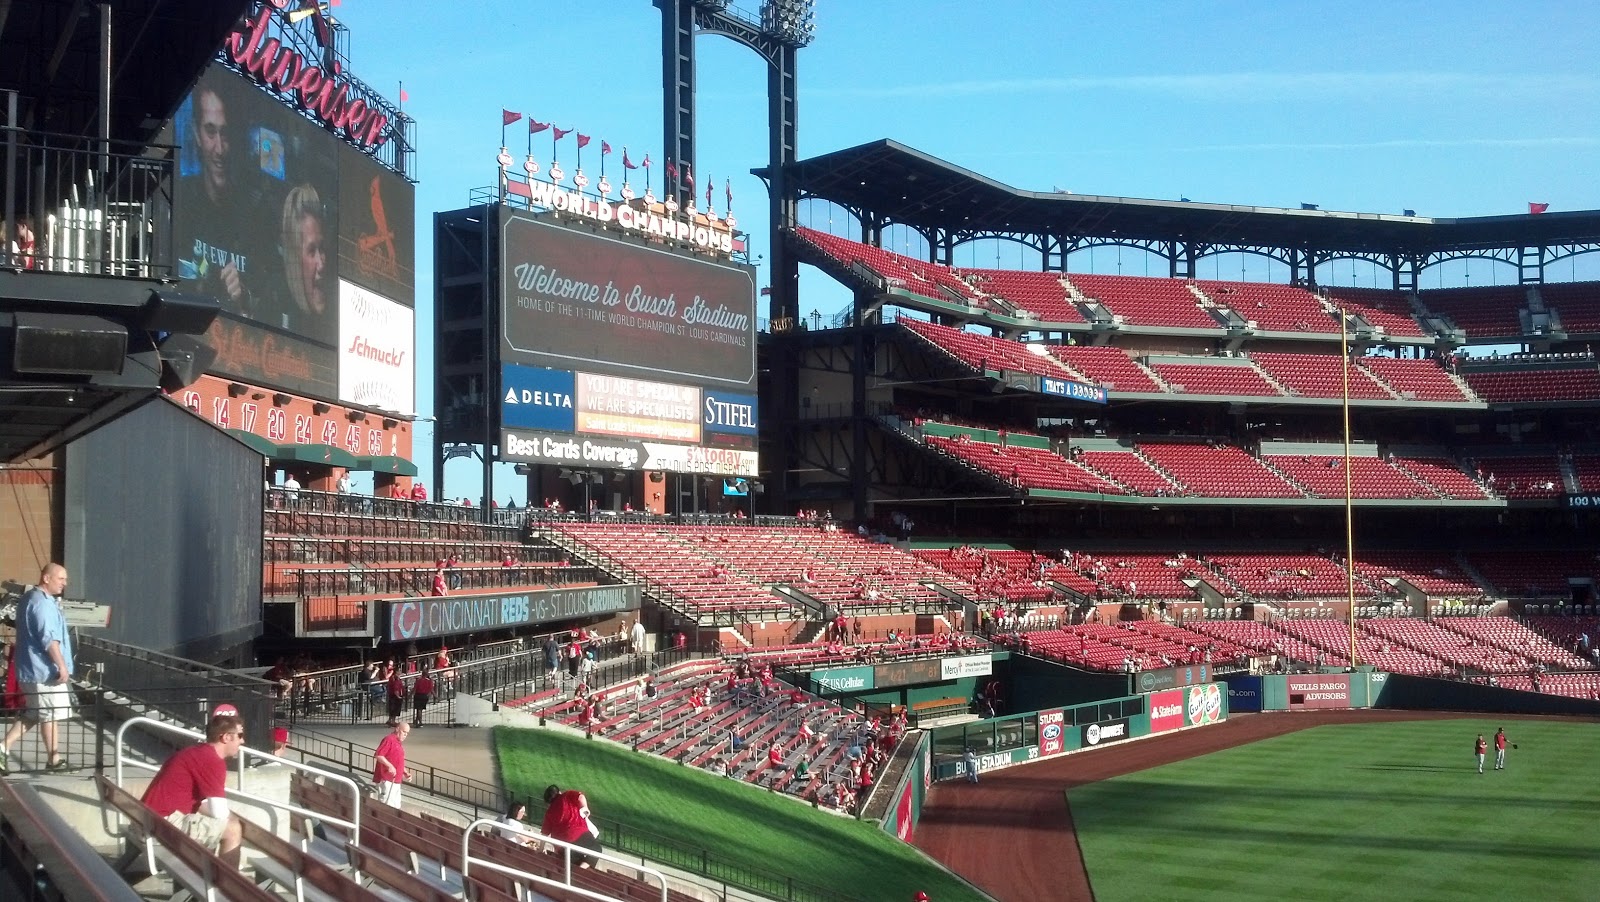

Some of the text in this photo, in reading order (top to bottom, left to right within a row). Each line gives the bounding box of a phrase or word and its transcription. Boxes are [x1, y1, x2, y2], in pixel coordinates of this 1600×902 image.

[529, 178, 733, 253] WORLD CHAMPIONS
[514, 262, 749, 332] Welcome to Busch Stadium
[517, 296, 542, 312] HOME
[545, 300, 556, 313] OF
[558, 303, 573, 317] THE
[576, 306, 606, 323] 11-TIME
[608, 313, 635, 328] WORLD
[637, 317, 676, 335] CHAMPION
[689, 327, 709, 341] LOUIS
[710, 331, 746, 347] CARDINALS
[348, 335, 405, 368] Schnucks
[522, 389, 572, 409] DELTA
[586, 376, 610, 394] YOU
[612, 379, 634, 397] ARE
[214, 397, 230, 429] 14
[242, 403, 258, 433] 17
[587, 395, 694, 421] WE ARE SPECIALISTS
[705, 396, 756, 429] STIFEL
[268, 408, 285, 440] 20
[295, 414, 312, 444] 24
[322, 420, 338, 448] 42
[345, 424, 361, 453] 45
[368, 429, 382, 456] 85
[507, 433, 638, 468] Best Cards Coverage
[429, 599, 499, 633] CINCINNATI
[501, 595, 529, 624] REDS
[564, 591, 586, 616] LOUIS
[587, 588, 627, 613] CARDINALS
[944, 665, 959, 676] Mercy
[1290, 682, 1346, 692] WELLS FARGO
[1306, 692, 1347, 701] ADVISORS
[1190, 696, 1204, 715] Gulf
[1205, 694, 1219, 712] Gulf
[956, 752, 1012, 775] BUH STADIUM
